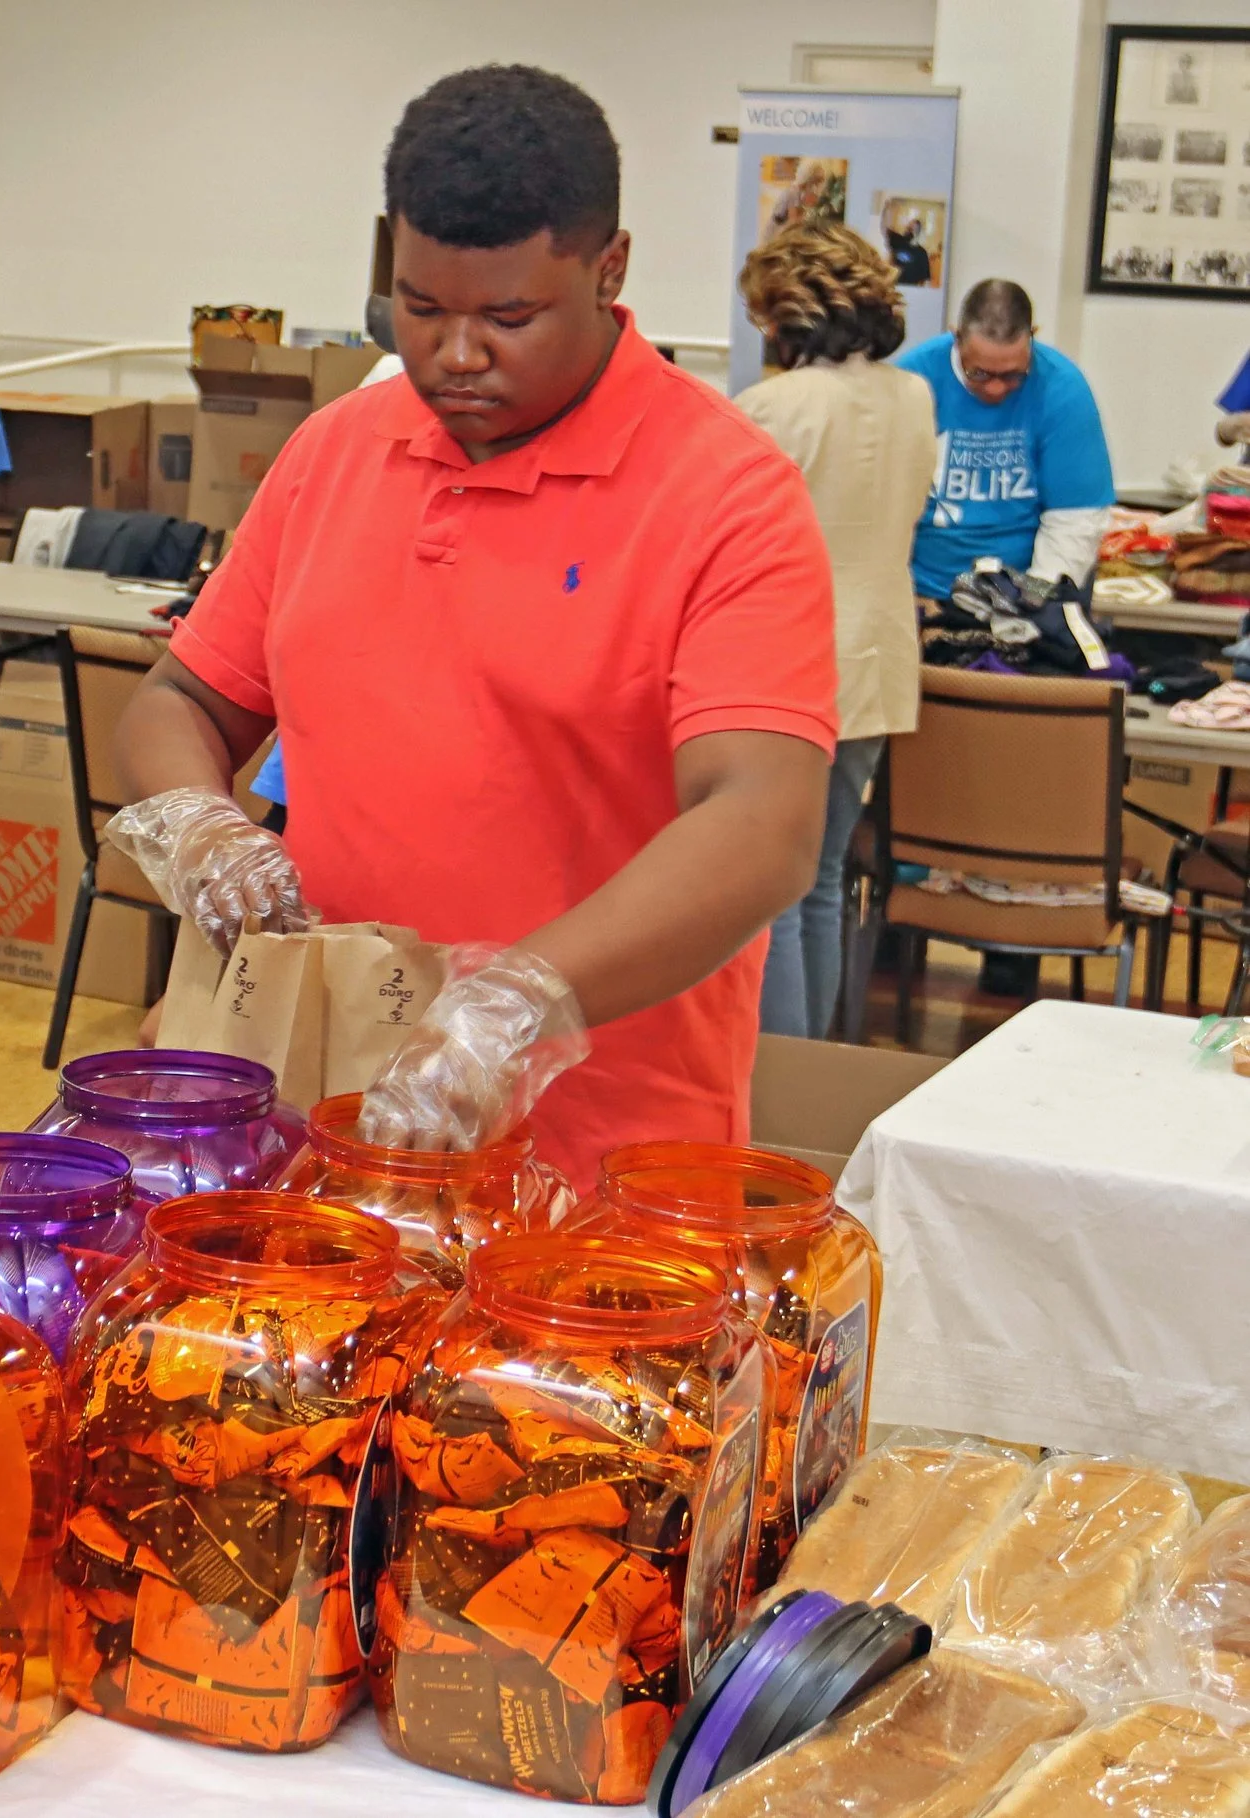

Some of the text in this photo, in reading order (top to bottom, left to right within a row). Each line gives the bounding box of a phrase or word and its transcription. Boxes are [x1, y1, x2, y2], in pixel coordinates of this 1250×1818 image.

[747, 107, 838, 129] WELCOME!
[950, 448, 1026, 467] MISSIONS
[3, 944, 42, 962] doers
[239, 957, 248, 973] 2
[392, 968, 404, 983] 2
[379, 988, 415, 998] DURO
[514, 1699, 535, 1761] PRETZELS
